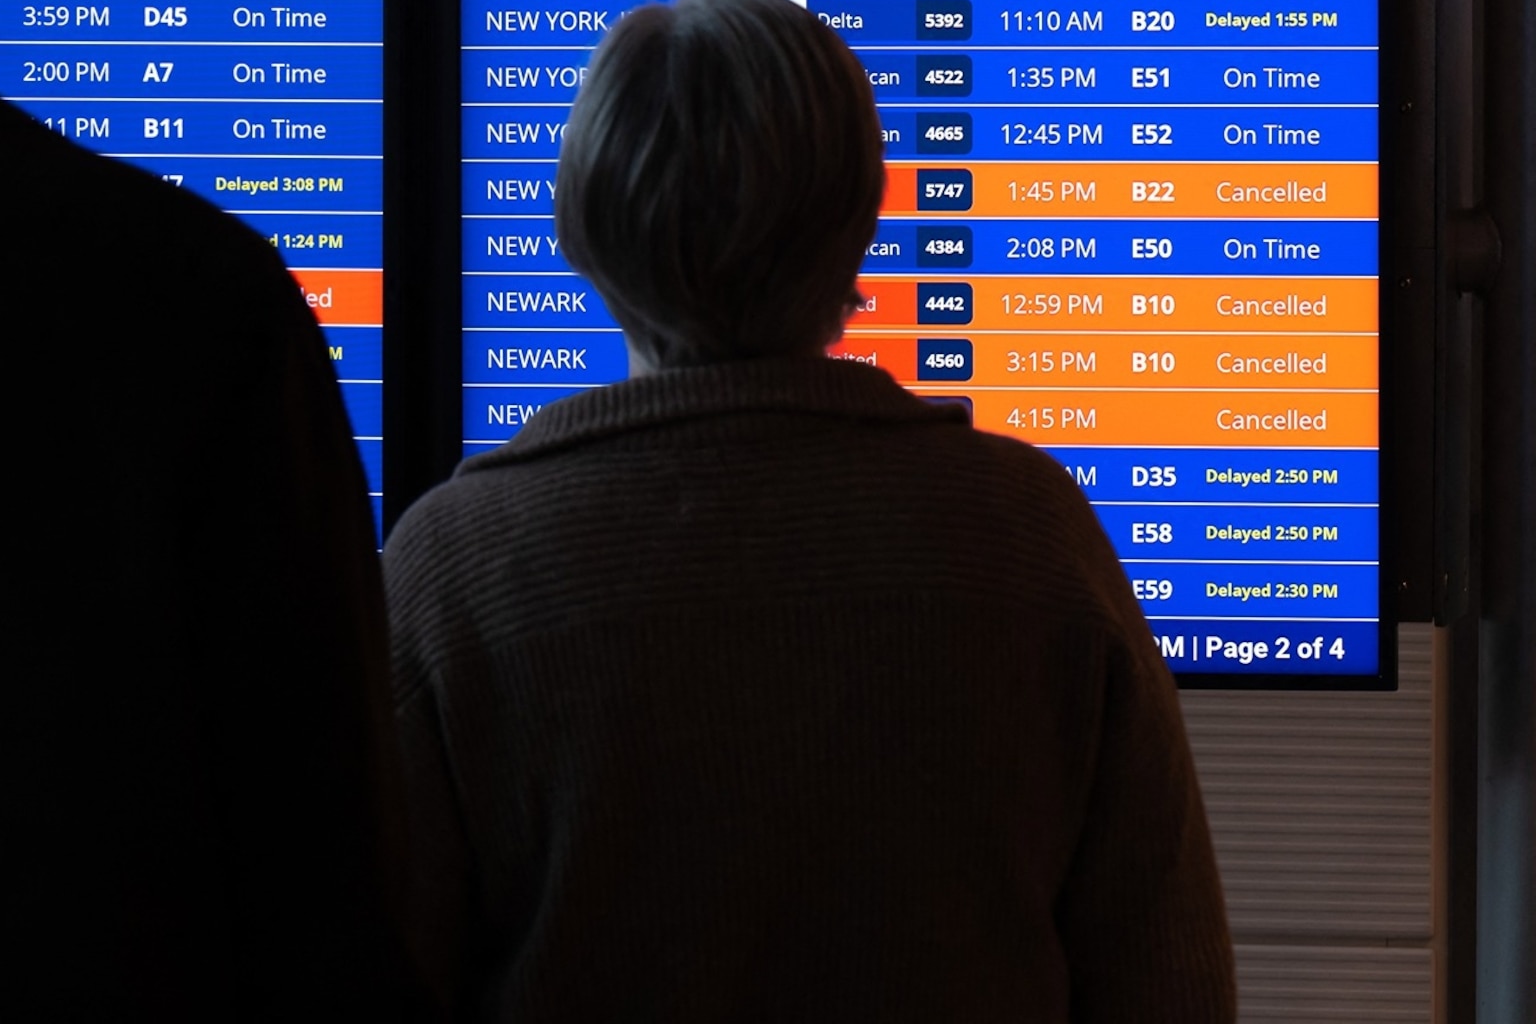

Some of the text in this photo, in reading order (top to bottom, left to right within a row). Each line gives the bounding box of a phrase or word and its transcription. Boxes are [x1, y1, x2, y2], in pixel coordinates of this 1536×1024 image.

[23, 6, 70, 26] 3:59
[76, 6, 110, 27] PM
[144, 6, 188, 27] D45
[232, 7, 266, 27] On
[270, 7, 327, 28] Time
[487, 291, 1327, 316] NEWARK 4442 12:59 PM B10 Cancelled
[1132, 523, 1338, 544] E58 Delayed 2:50 PM
[1205, 635, 1269, 665] Page
[1274, 636, 1291, 659] 2
[1296, 636, 1324, 659] of
[1328, 637, 1346, 660] 4
